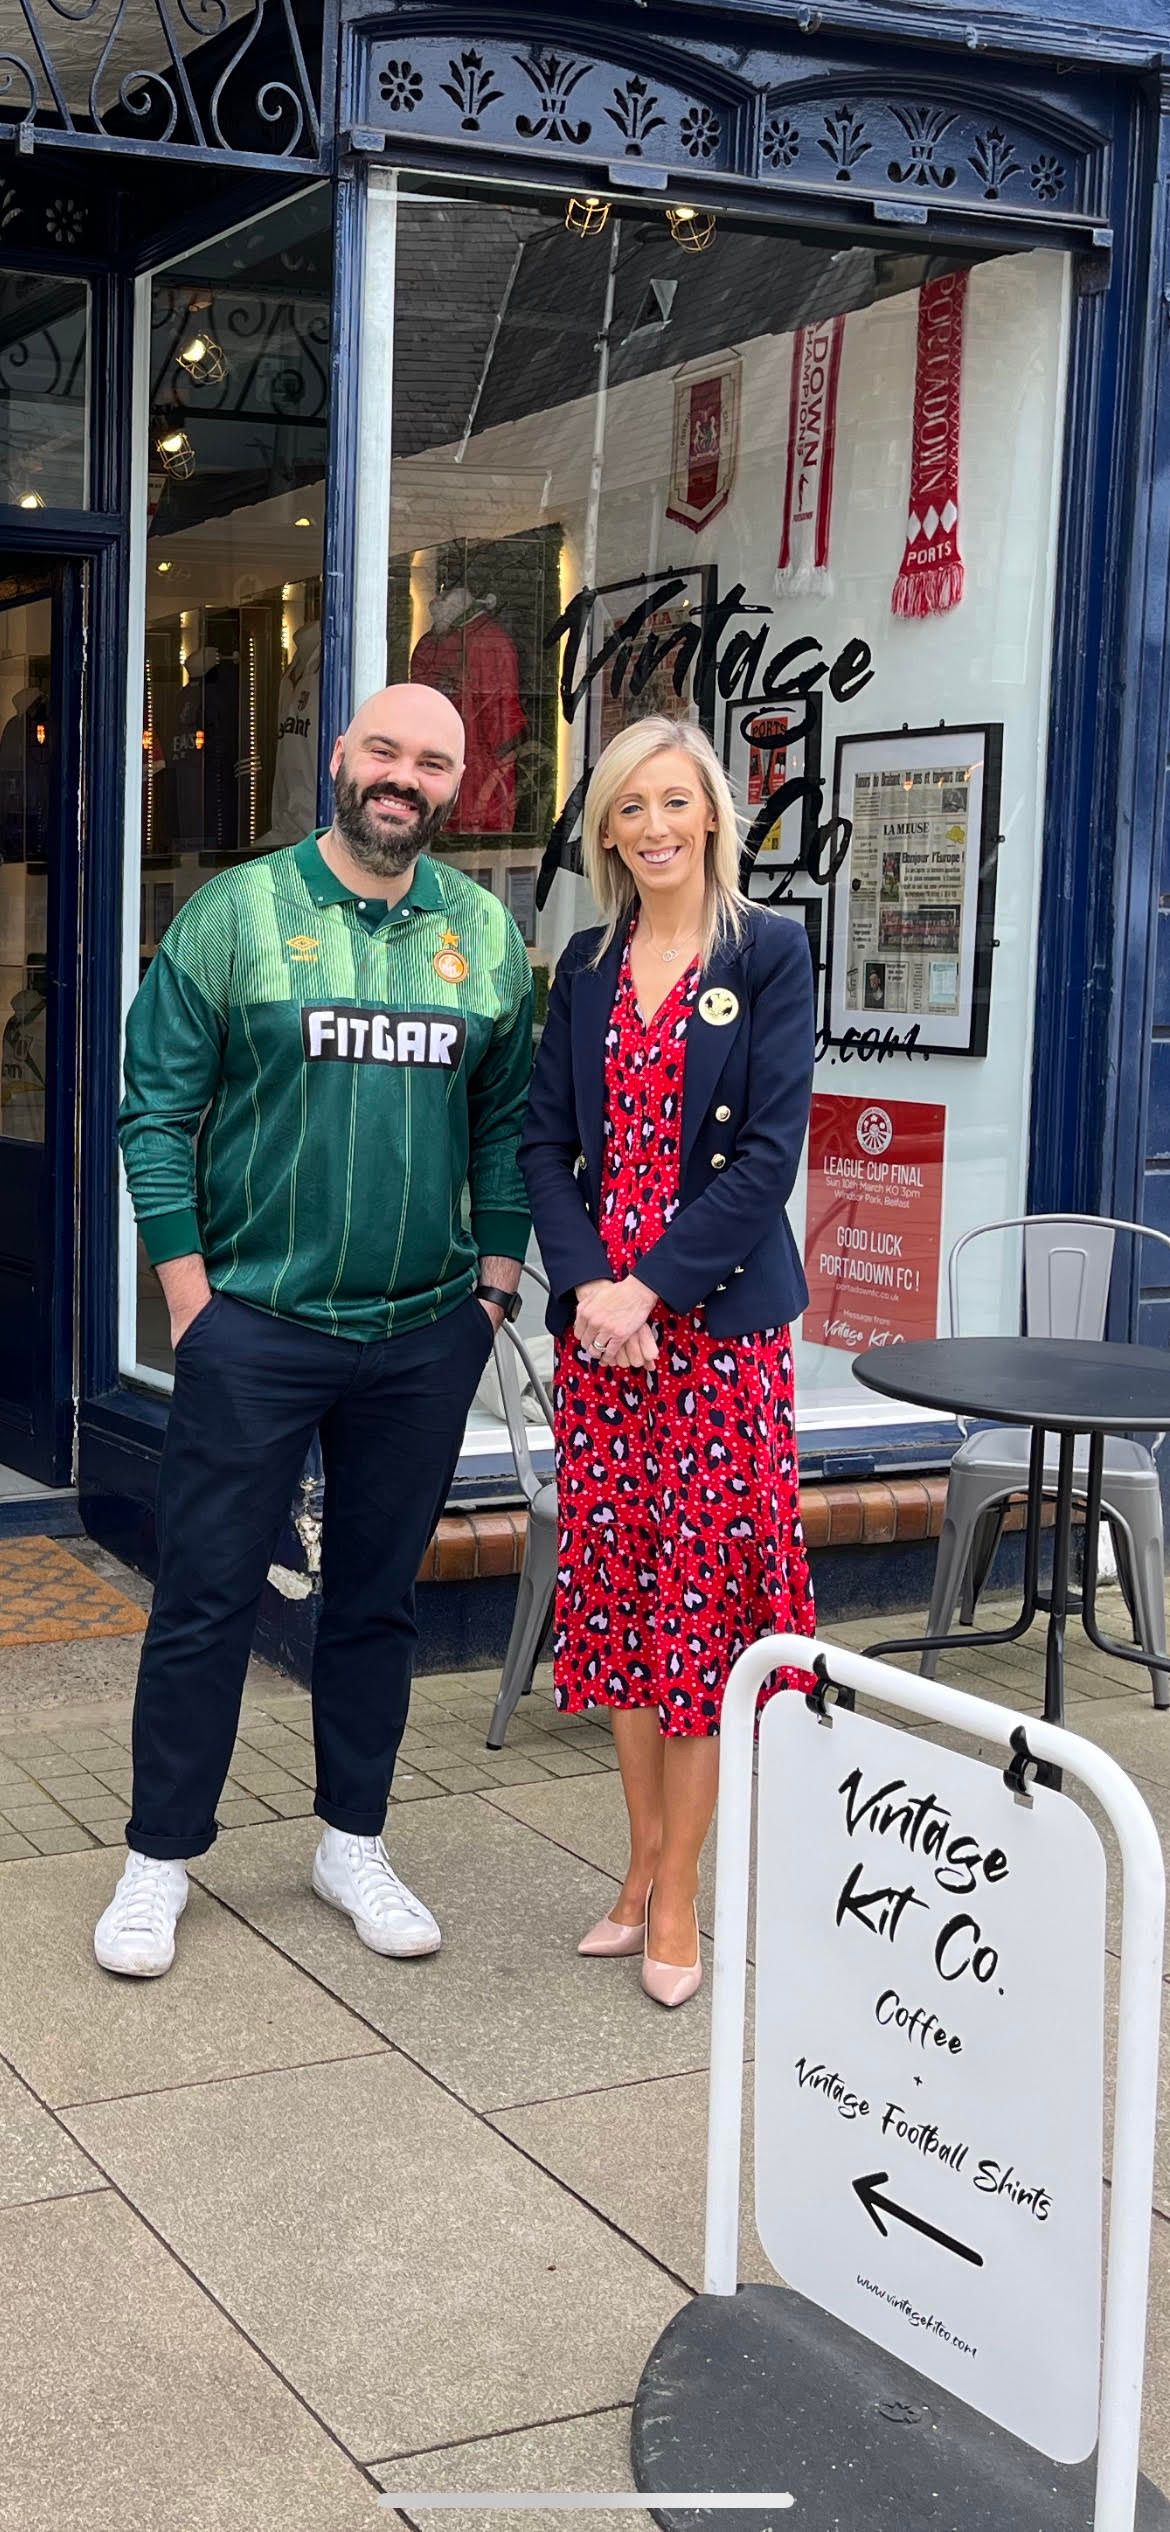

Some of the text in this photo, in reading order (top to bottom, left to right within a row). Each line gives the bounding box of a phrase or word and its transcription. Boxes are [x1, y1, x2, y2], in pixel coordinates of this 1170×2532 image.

[919, 273, 957, 495] PORTADOWN
[906, 540, 952, 566] PORTS
[543, 578, 875, 750] Vintage
[751, 719, 787, 738] PORTS
[308, 1010, 458, 1065] FITGAR
[823, 1156, 924, 1187] LEAGUE CUP FINAL
[826, 1176, 840, 1187] Sun
[860, 1182, 884, 1194] March
[886, 1185, 899, 1196] KO
[900, 1186, 921, 1199] 3pm
[834, 1190, 863, 1202] Windsor
[884, 1197, 910, 1209] Belfast
[837, 1226, 903, 1257] GOOD LUCK
[820, 1253, 894, 1287] PORTADOWN
[896, 1267, 913, 1291] FC
[823, 1319, 864, 1347] Vintage
[868, 1327, 894, 1347] Kit
[838, 1767, 1010, 1894] Vintage
[835, 1862, 1005, 1996] Kit Co.
[875, 1988, 963, 2055] Coffee
[794, 2056, 1054, 2222] Vintage Football Shirts
